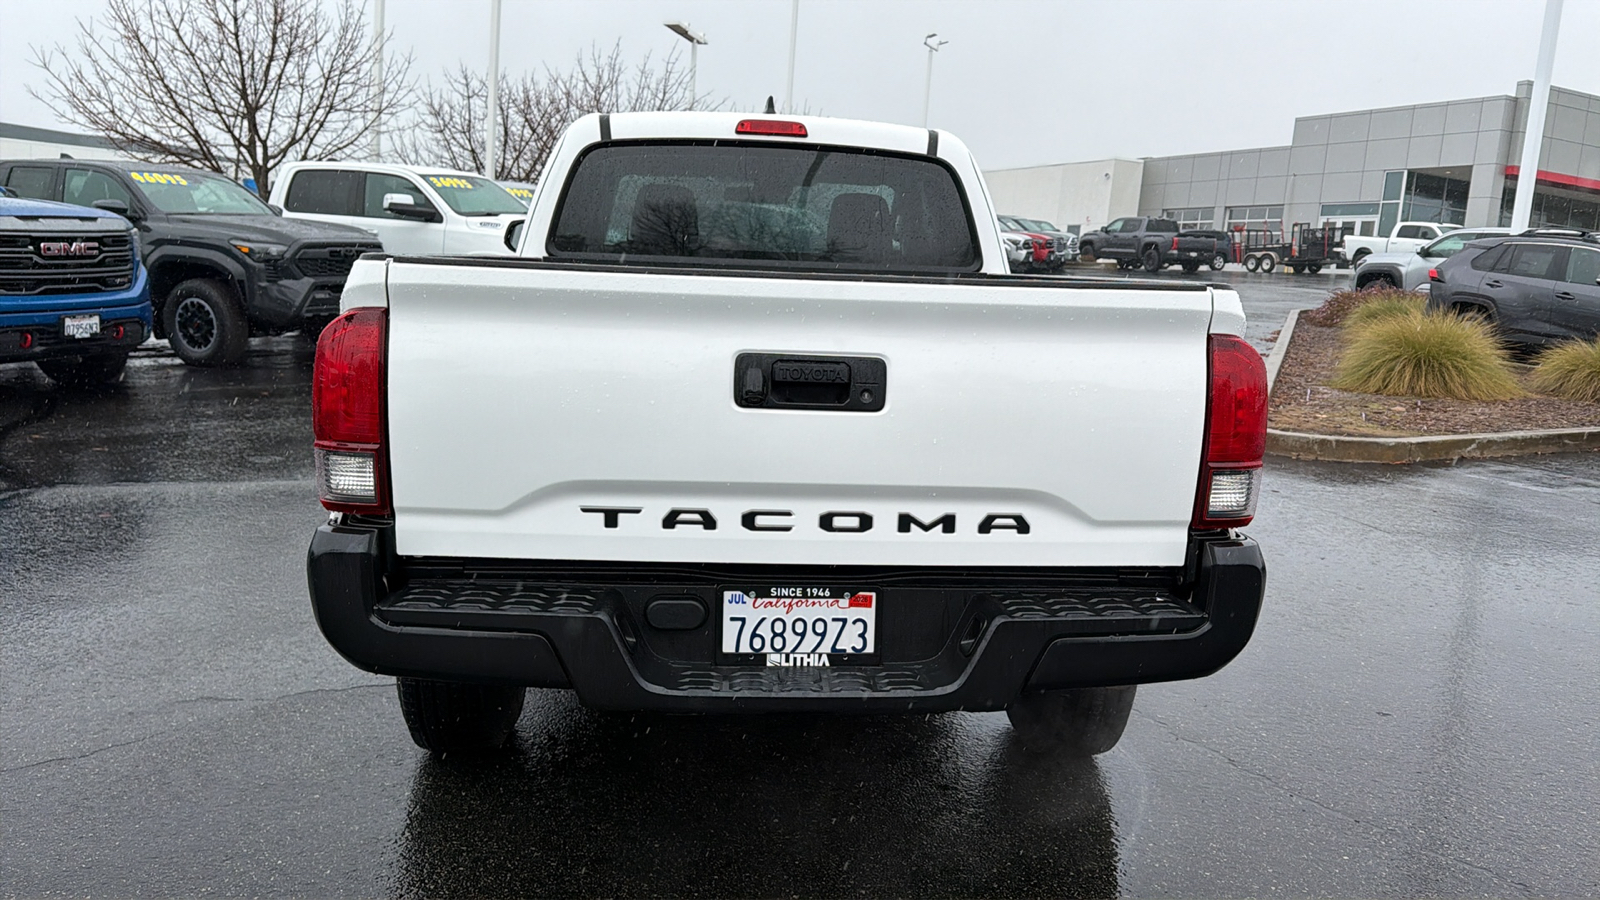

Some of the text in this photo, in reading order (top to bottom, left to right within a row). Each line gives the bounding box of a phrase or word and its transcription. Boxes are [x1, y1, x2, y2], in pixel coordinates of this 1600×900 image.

[40, 242, 99, 256] GMC
[779, 367, 845, 383] TOYOTA
[579, 505, 1031, 535] TACOMA
[727, 593, 747, 605] JUL
[770, 587, 831, 597] SINCE 1946
[752, 598, 851, 615] California
[729, 617, 868, 653] 76899Z3
[779, 653, 830, 667] LITHIA
